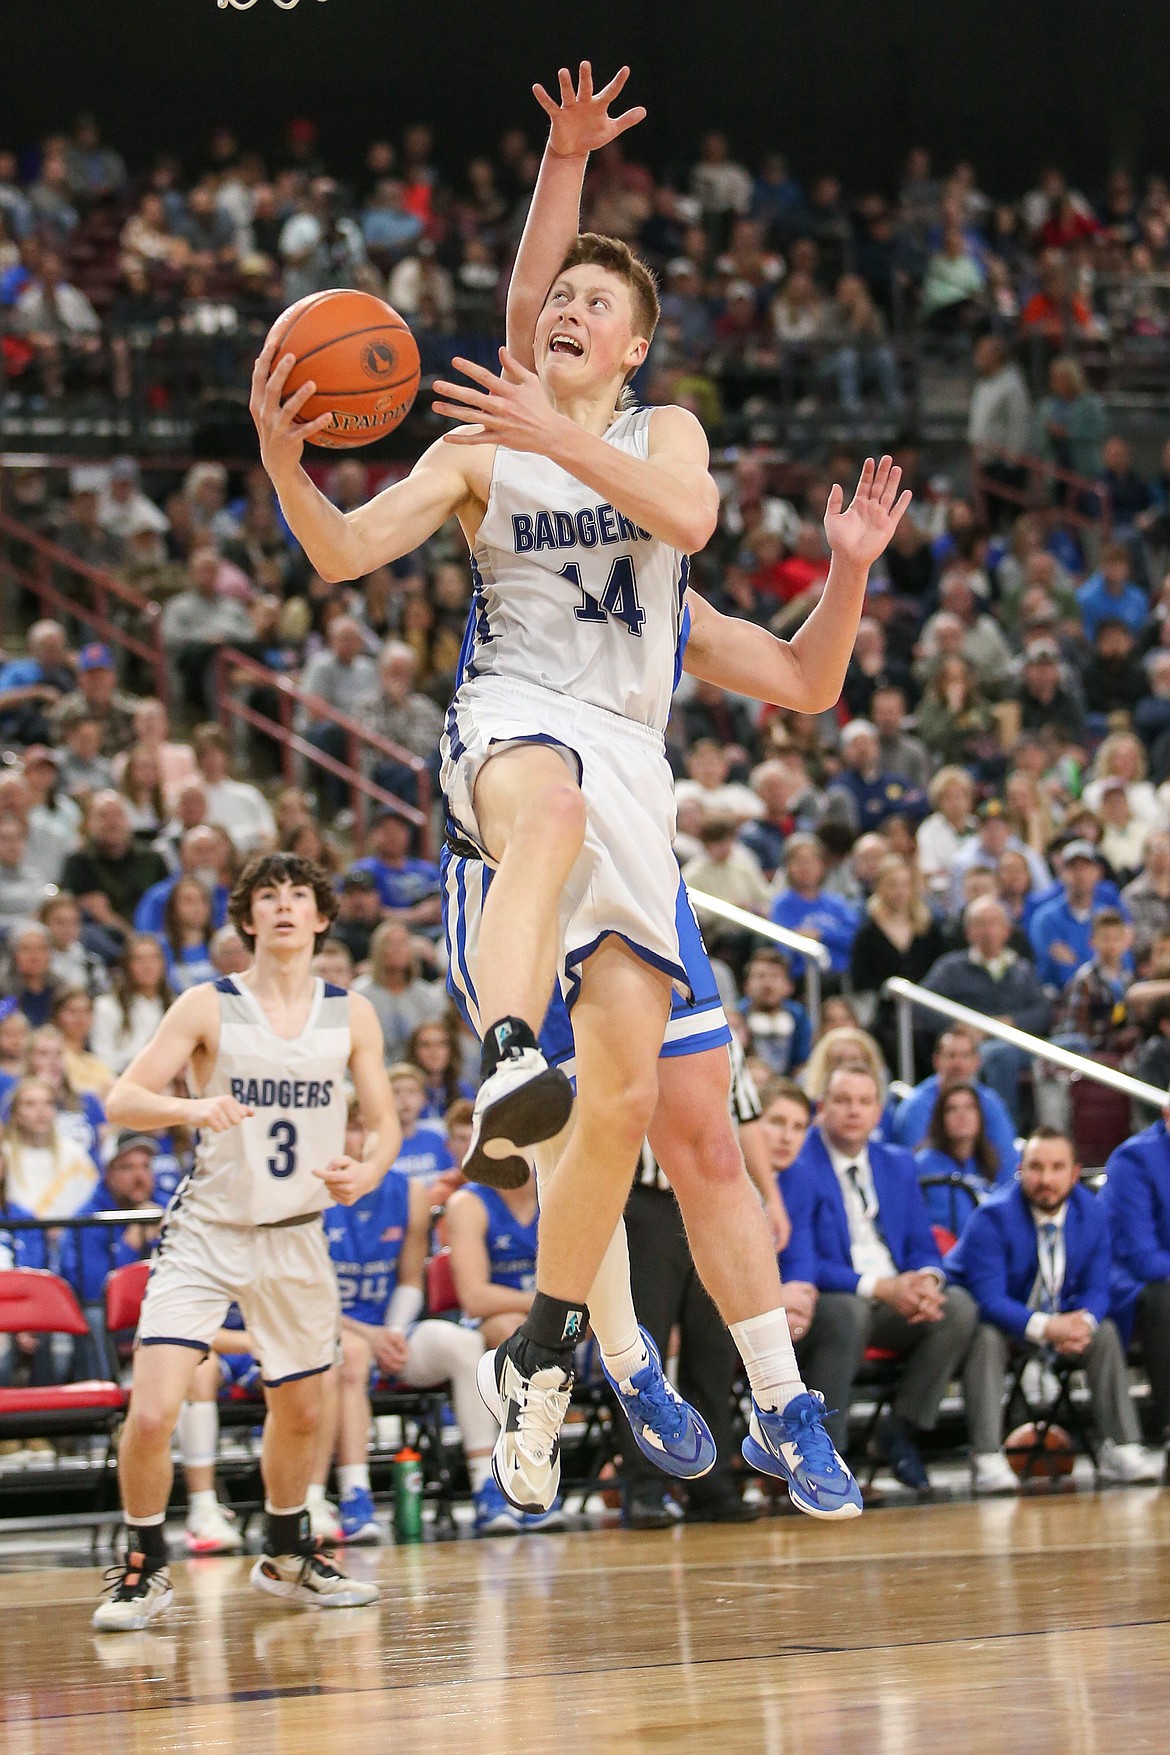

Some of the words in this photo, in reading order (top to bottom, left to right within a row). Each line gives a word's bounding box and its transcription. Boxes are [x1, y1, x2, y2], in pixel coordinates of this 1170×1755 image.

[555, 555, 646, 637] 14
[230, 1078, 334, 1109] BADGERS
[267, 1118, 298, 1179] 3
